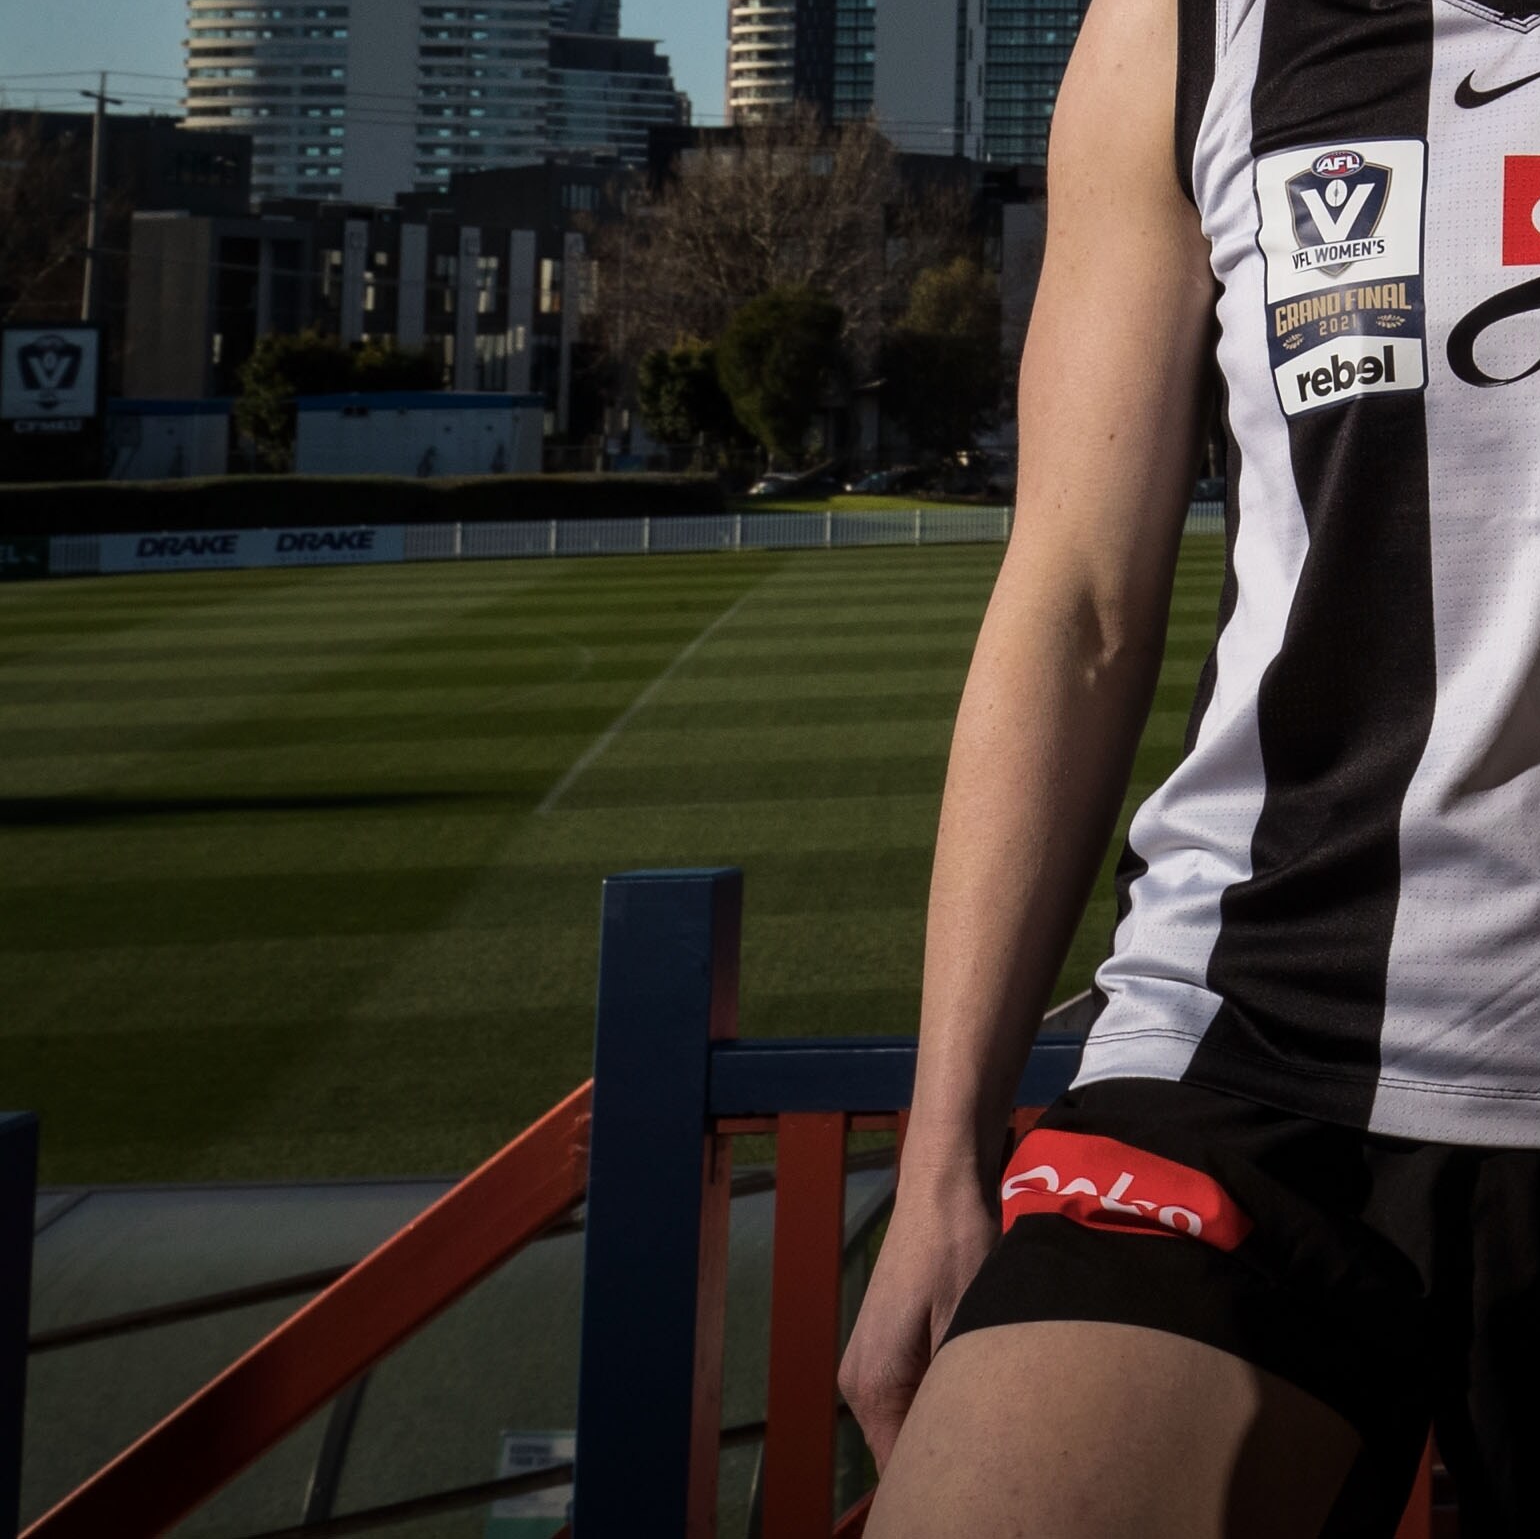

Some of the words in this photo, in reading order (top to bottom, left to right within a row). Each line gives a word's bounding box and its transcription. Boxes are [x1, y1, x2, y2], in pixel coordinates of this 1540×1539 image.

[1317, 156, 1360, 173] AFL
[1292, 251, 1312, 270] VFL
[1315, 239, 1385, 263] WOMEN'S
[1275, 292, 1341, 338] GRAND
[1345, 282, 1412, 311] FINAL
[1319, 313, 1359, 336] 2021
[1296, 345, 1396, 402] rebel
[136, 534, 239, 558] DRAKE
[275, 530, 376, 553] DRAKE
